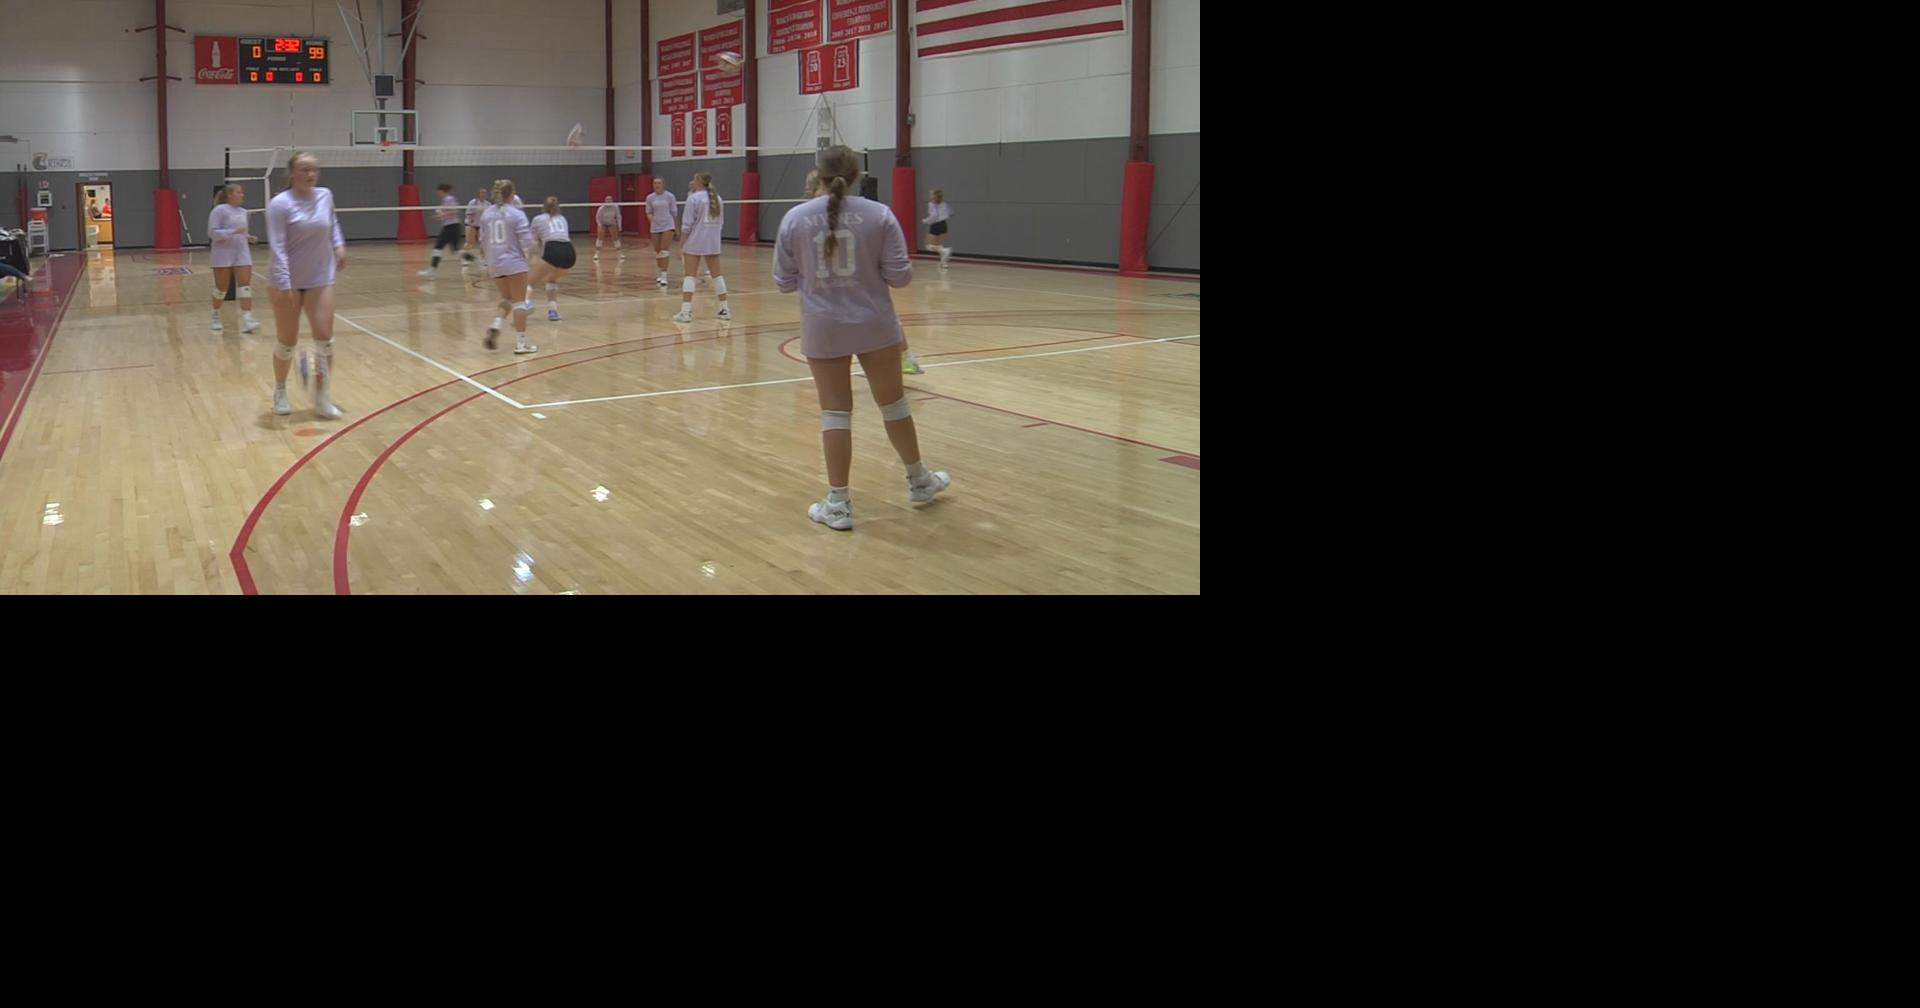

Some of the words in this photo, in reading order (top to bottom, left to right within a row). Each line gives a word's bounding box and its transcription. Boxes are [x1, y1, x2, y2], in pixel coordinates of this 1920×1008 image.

[252, 46, 261, 58] 0
[308, 46, 324, 59] 99
[250, 72, 258, 81] 0
[312, 72, 320, 82] 0
[487, 219, 506, 244] 10
[813, 229, 856, 278] 10
